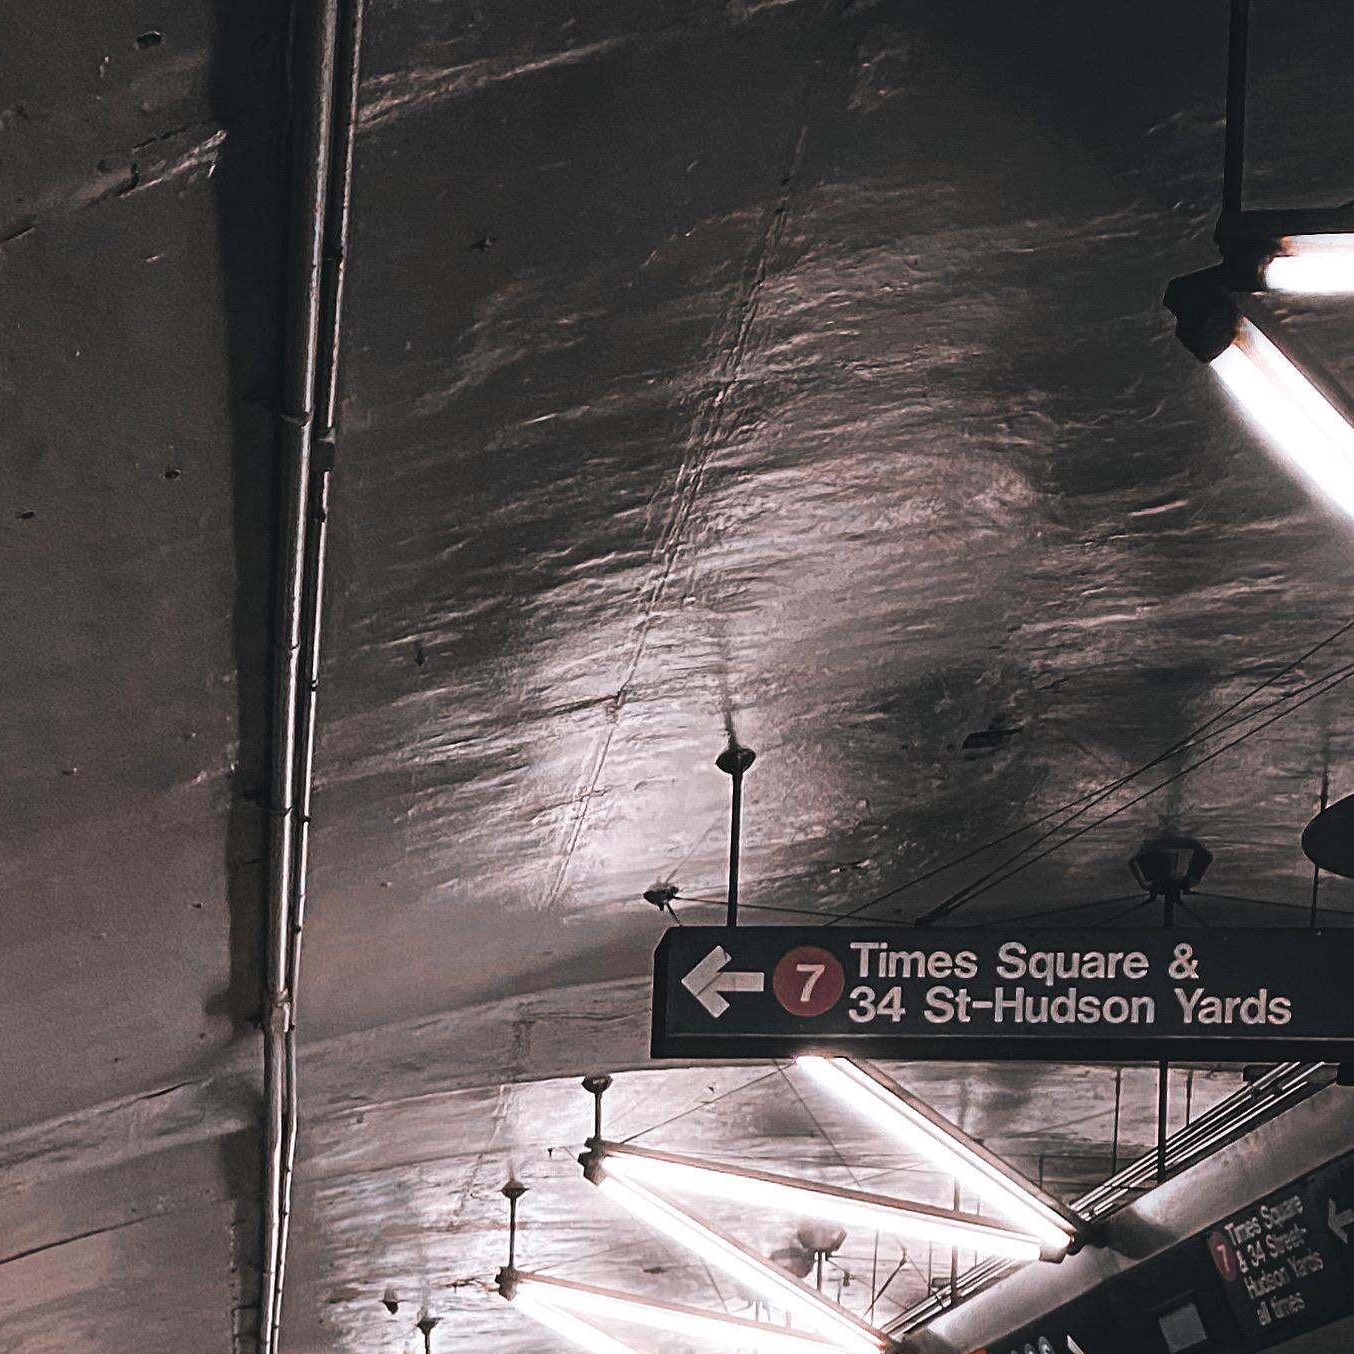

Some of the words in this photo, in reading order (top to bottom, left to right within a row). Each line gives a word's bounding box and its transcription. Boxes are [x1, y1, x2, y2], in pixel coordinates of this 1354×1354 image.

[796, 964, 826, 1003] 7
[850, 942, 978, 979] Times
[997, 942, 1148, 987] Square
[1168, 943, 1198, 979] &
[849, 987, 905, 1024] 34
[924, 987, 1155, 1024] St-Hudson
[1175, 988, 1293, 1025] Yards
[1224, 1217, 1261, 1246] Times
[1260, 1195, 1303, 1229] Square
[1216, 1244, 1231, 1272] 7
[1247, 1241, 1266, 1267] 34
[1244, 1267, 1289, 1299] Hudson
